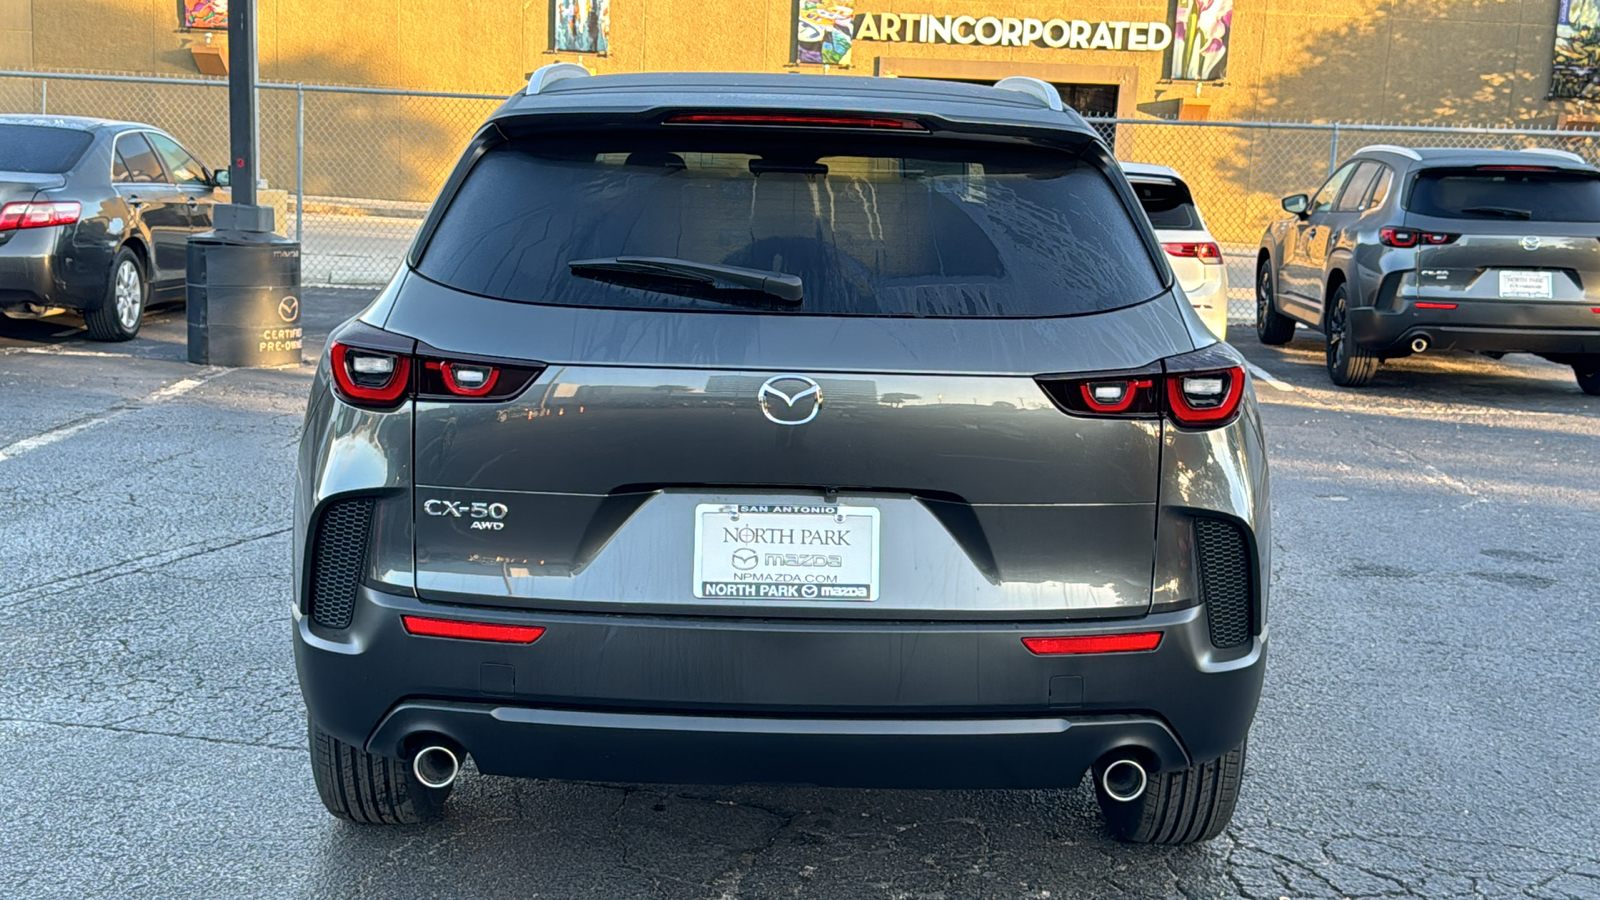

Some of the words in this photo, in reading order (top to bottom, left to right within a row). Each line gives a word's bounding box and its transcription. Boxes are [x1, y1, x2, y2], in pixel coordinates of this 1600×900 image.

[856, 11, 1172, 51] ARTINCORPORATED
[423, 499, 508, 519] CX-50
[740, 505, 769, 513] SAN
[772, 506, 836, 514] ANTONIO
[470, 521, 505, 531] AWD
[723, 525, 795, 545] NORTH
[800, 529, 851, 546] PARK
[764, 553, 842, 567] mazda
[733, 572, 838, 583] NPMAZDA.COM
[705, 584, 756, 596] NORTH
[760, 585, 799, 597] PARK
[820, 586, 868, 597] mazda
